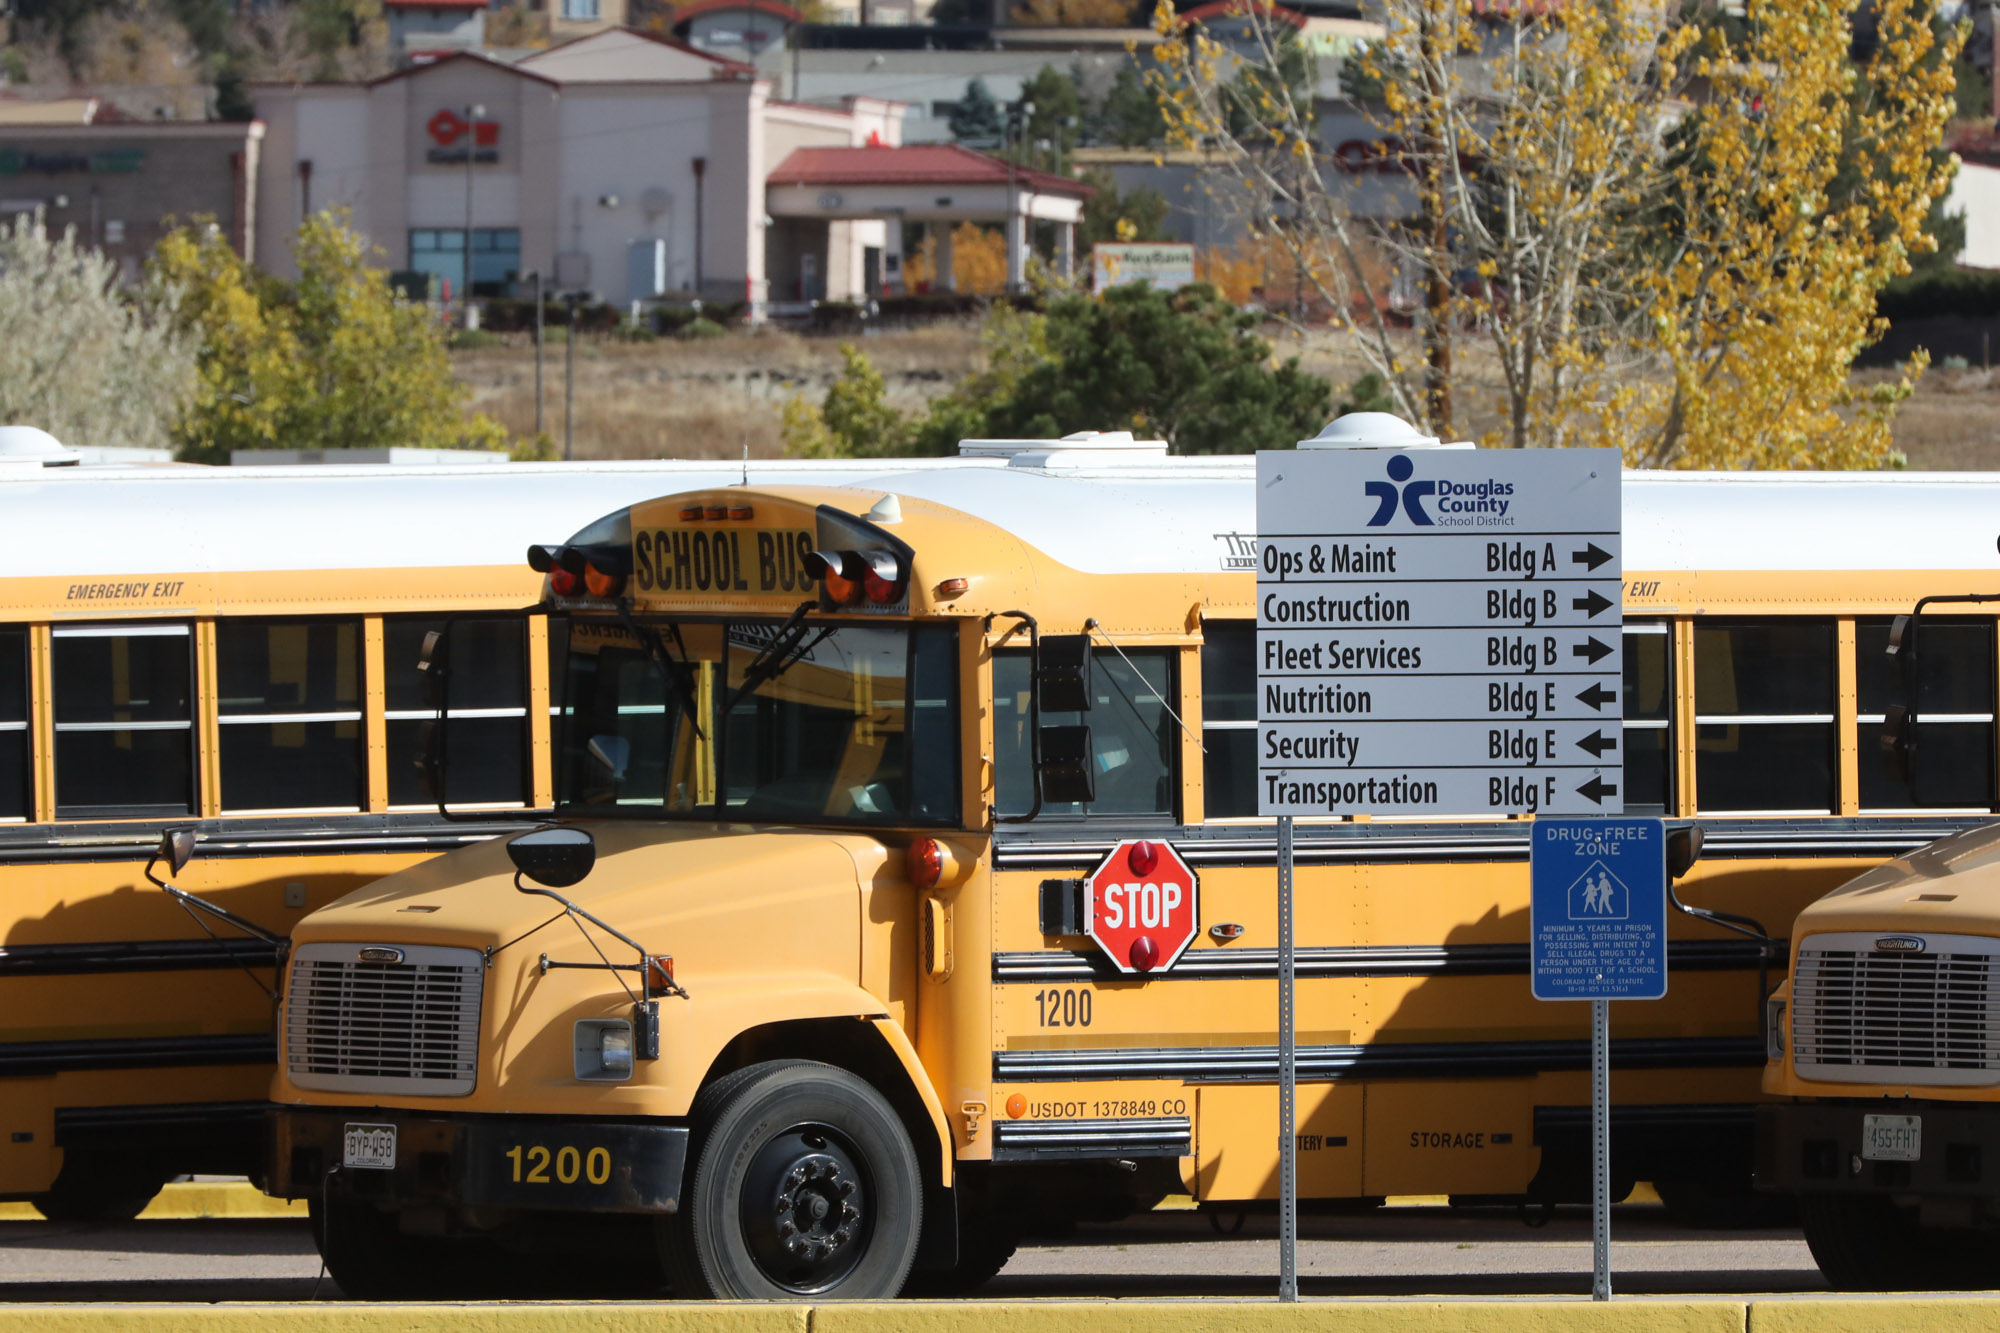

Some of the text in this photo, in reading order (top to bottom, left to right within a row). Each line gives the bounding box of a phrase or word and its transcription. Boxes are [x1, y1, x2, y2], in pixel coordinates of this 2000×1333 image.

[1438, 478, 1514, 500] Douglas
[1438, 497, 1509, 517] County
[1438, 516, 1515, 526] School District
[636, 530, 815, 592] SCHOOL BUS
[1263, 542, 1556, 581] Ops & Maint Bldg A
[67, 582, 184, 599] EMERGENCY EXIT
[1264, 589, 1557, 626] Construction Bldg B
[1630, 582, 1661, 596] EXIT
[1265, 636, 1557, 673] Fleet Services Bldg B
[1266, 682, 1556, 719] Nutrition Bldg E
[1266, 729, 1556, 766] Security Bldg E
[1266, 774, 1556, 812] Transportation Bldg F
[1547, 827, 1648, 840] DRUG-FREE
[1575, 843, 1621, 856] ZONE
[1104, 882, 1182, 929] STOP
[1035, 989, 1092, 1027] 1200
[1031, 1099, 1186, 1118] USDOT 1378849 CO
[1410, 1132, 1484, 1148] STORAGE
[506, 1145, 611, 1184] 1200
